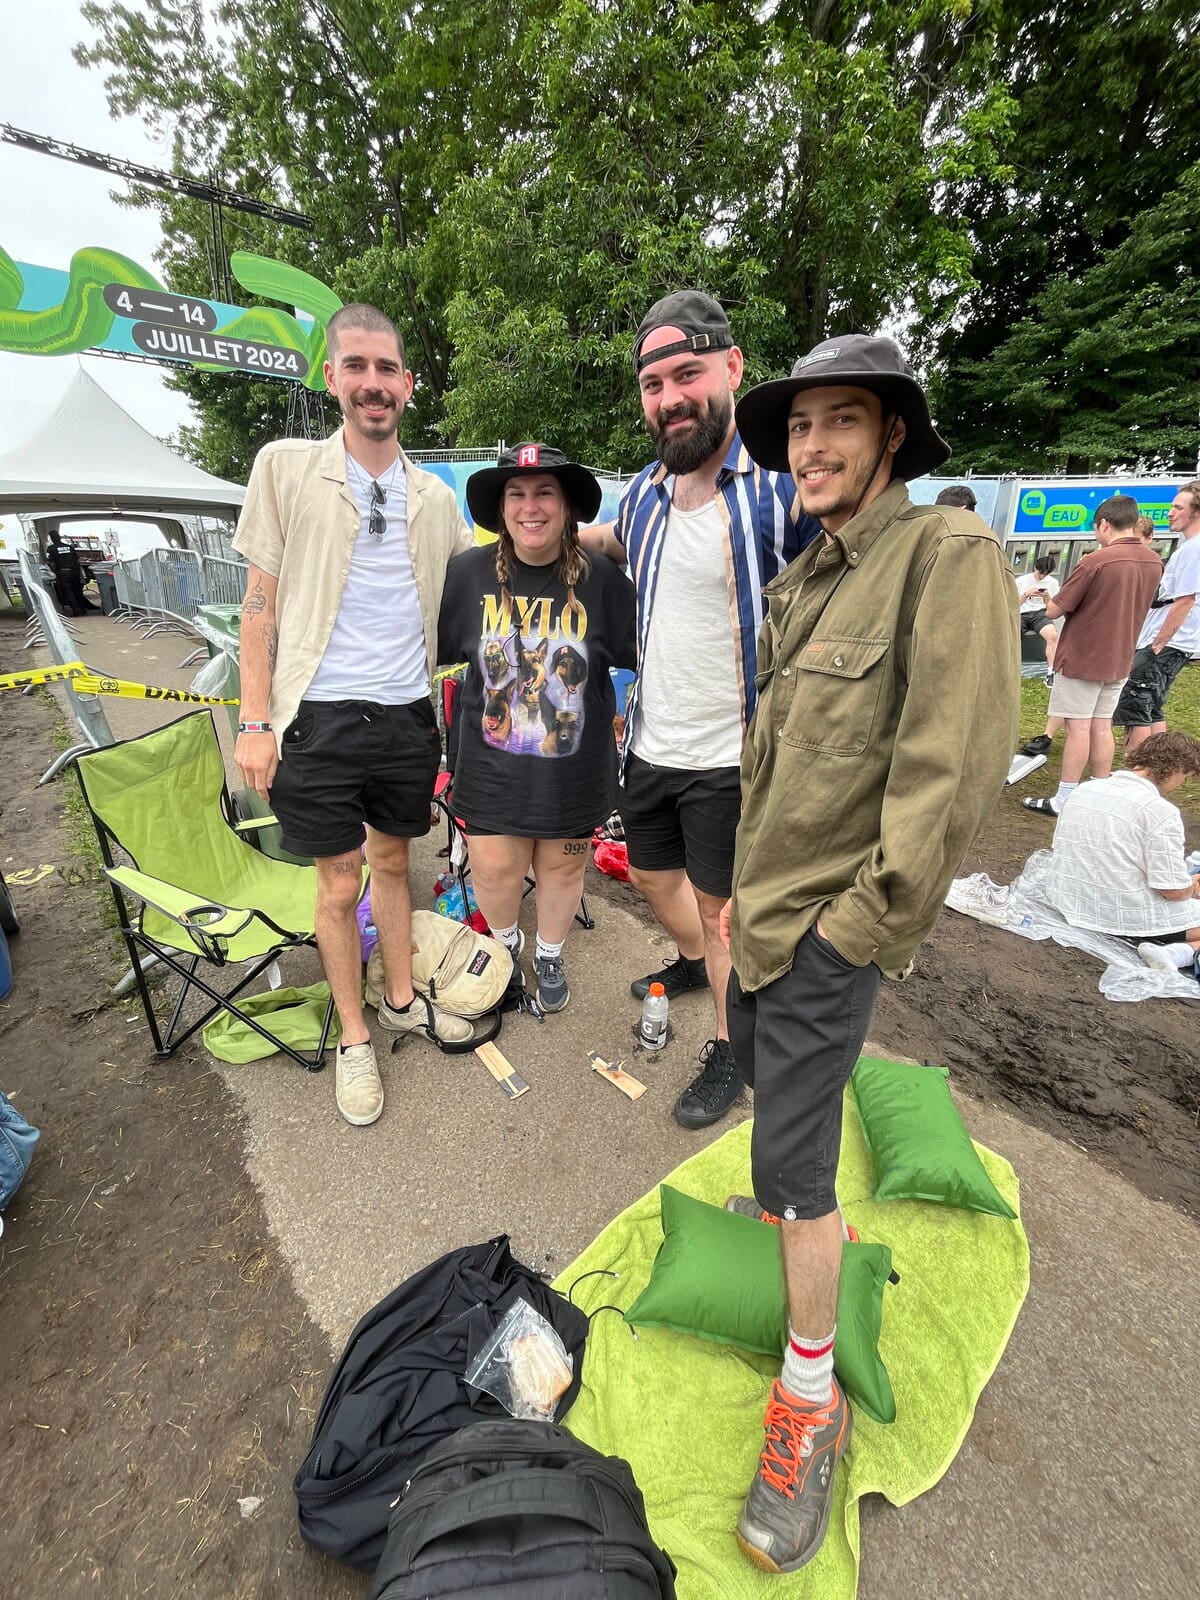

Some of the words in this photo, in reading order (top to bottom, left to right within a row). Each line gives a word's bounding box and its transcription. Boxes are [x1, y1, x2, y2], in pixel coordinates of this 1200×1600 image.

[116, 290, 134, 312] 4
[178, 303, 206, 326] 14
[145, 329, 243, 363] JUILLET
[245, 347, 299, 373] 2024
[1051, 510, 1080, 522] EAU
[480, 594, 588, 644] MYLO
[562, 842, 588, 856] 999
